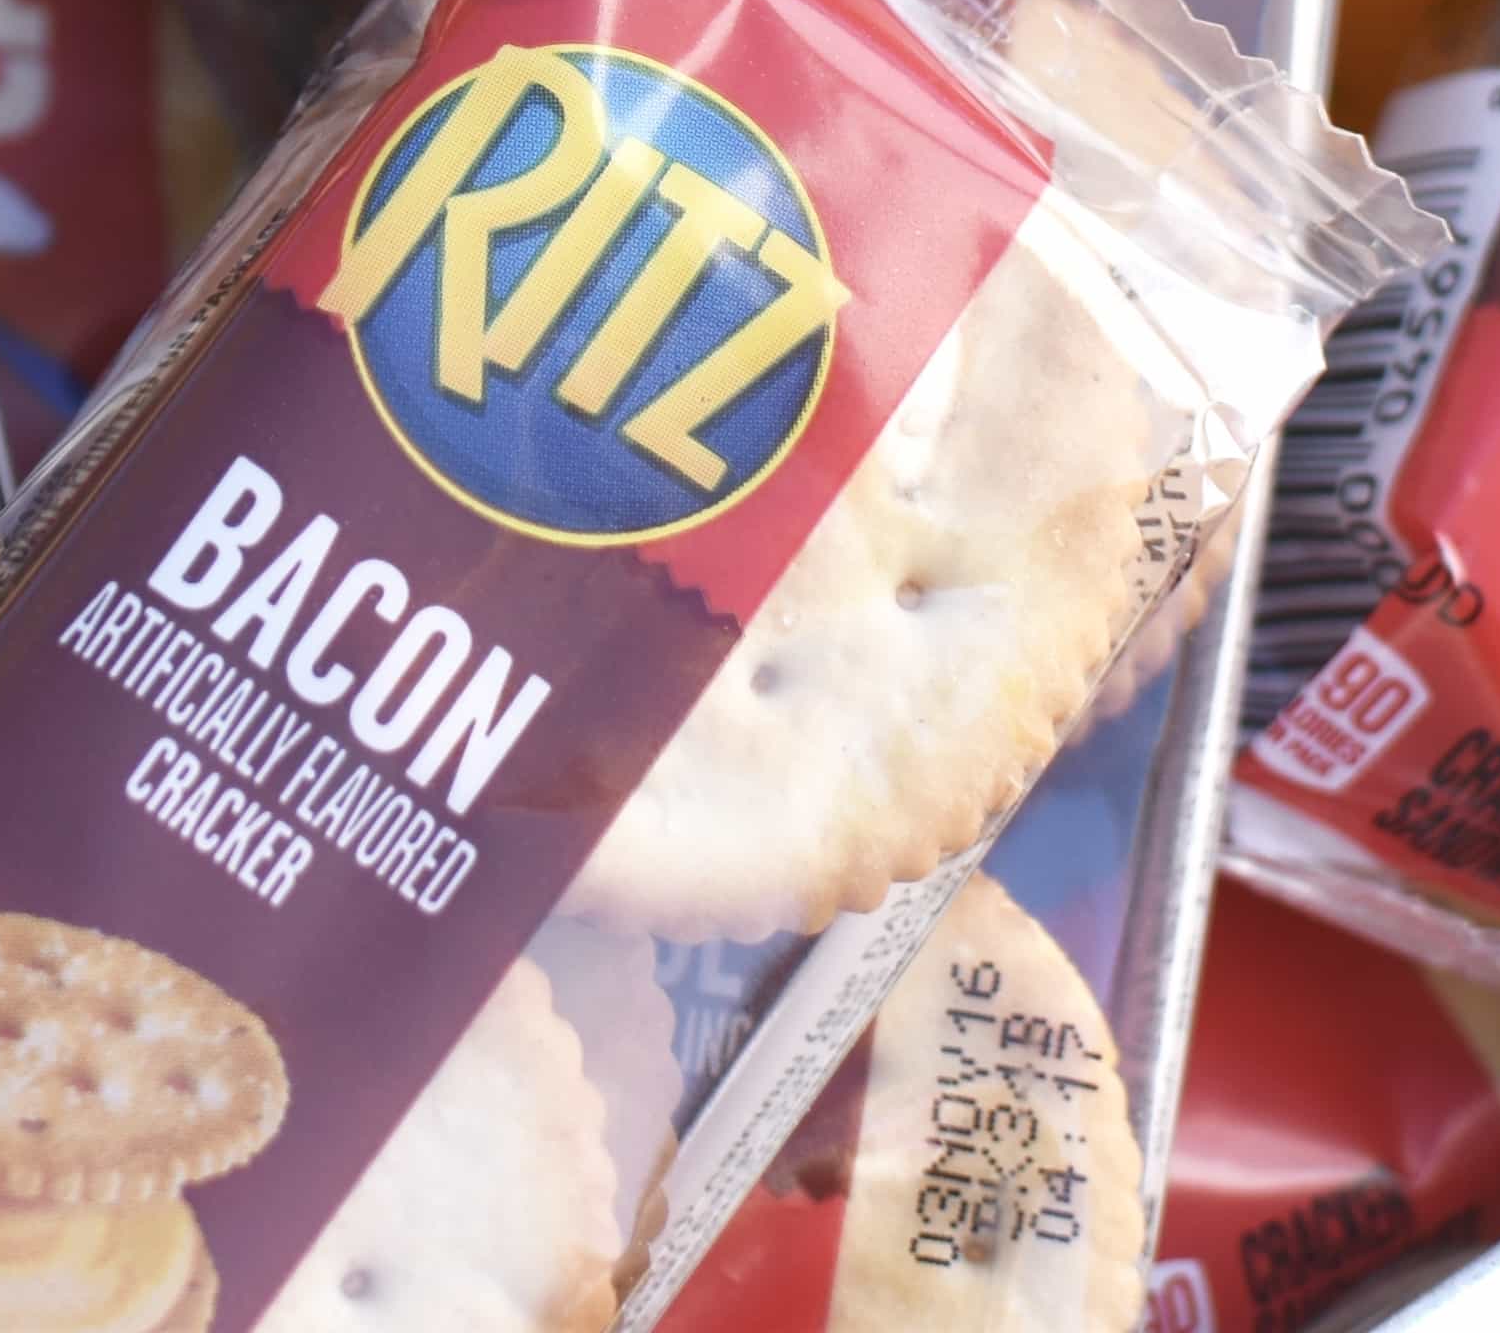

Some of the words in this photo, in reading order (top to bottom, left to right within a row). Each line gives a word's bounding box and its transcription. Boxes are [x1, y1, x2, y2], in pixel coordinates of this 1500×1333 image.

[317, 45, 852, 493] RITZ
[58, 580, 311, 794] ARTIFICIALLY
[291, 741, 479, 918] FLAVORED
[147, 455, 553, 815] BACON
[1319, 655, 1412, 736] 90
[125, 736, 315, 911] CRACKER
[909, 960, 1001, 1267] 03NOV16
